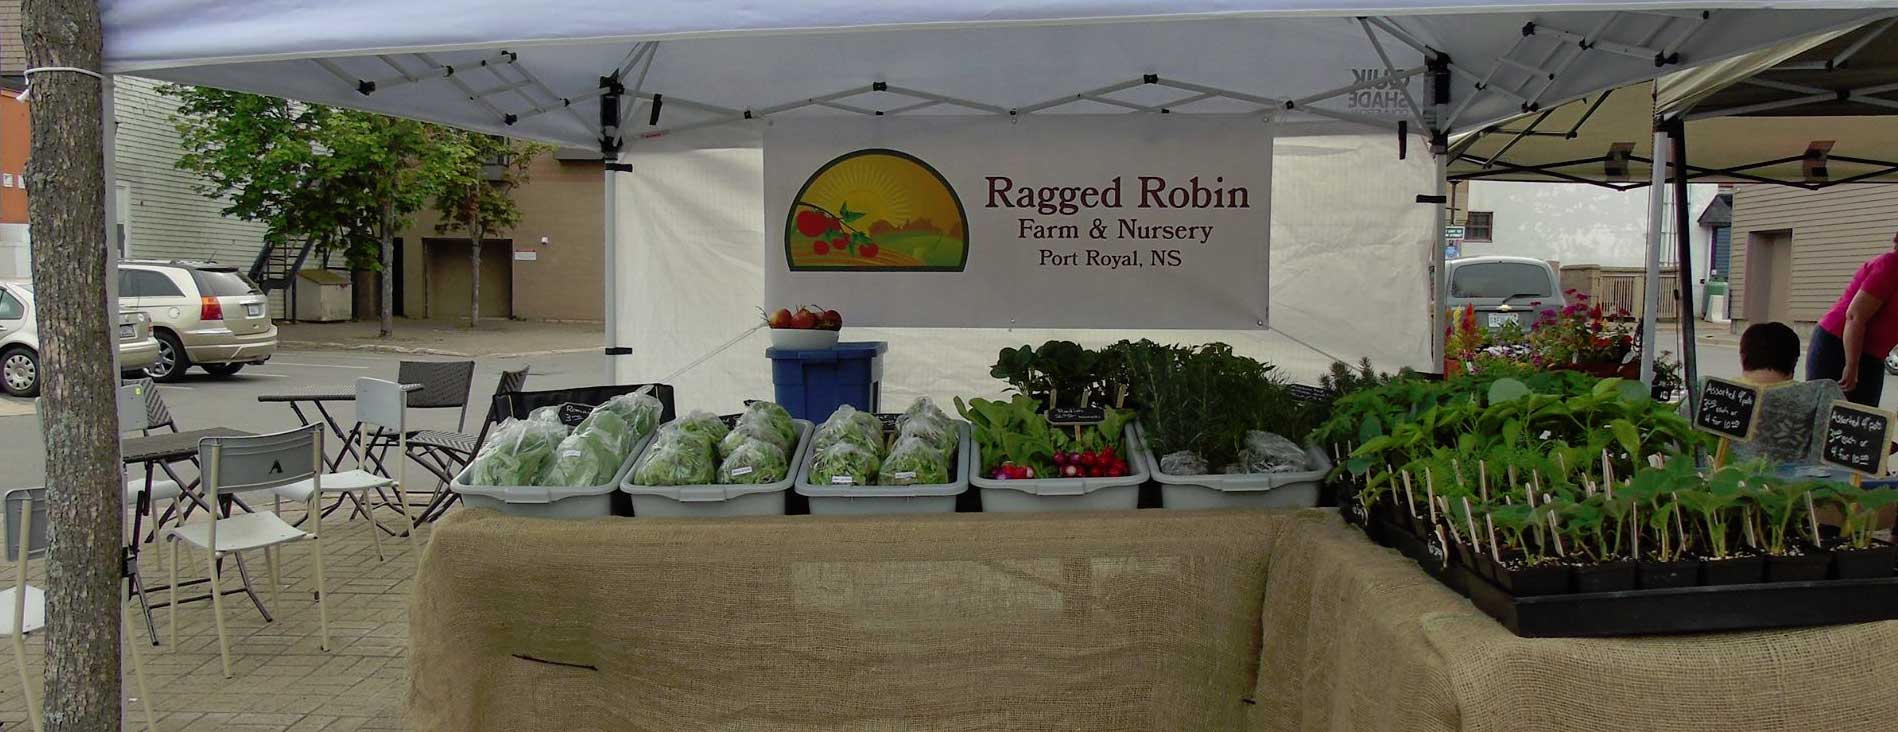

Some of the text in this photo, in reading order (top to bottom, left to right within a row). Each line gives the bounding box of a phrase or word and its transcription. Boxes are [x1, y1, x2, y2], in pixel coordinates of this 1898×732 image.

[985, 177, 1249, 215] Ragged Robin
[1018, 218, 1213, 243] Farm & Nursery
[1040, 250, 1181, 269] Port Royal, NS
